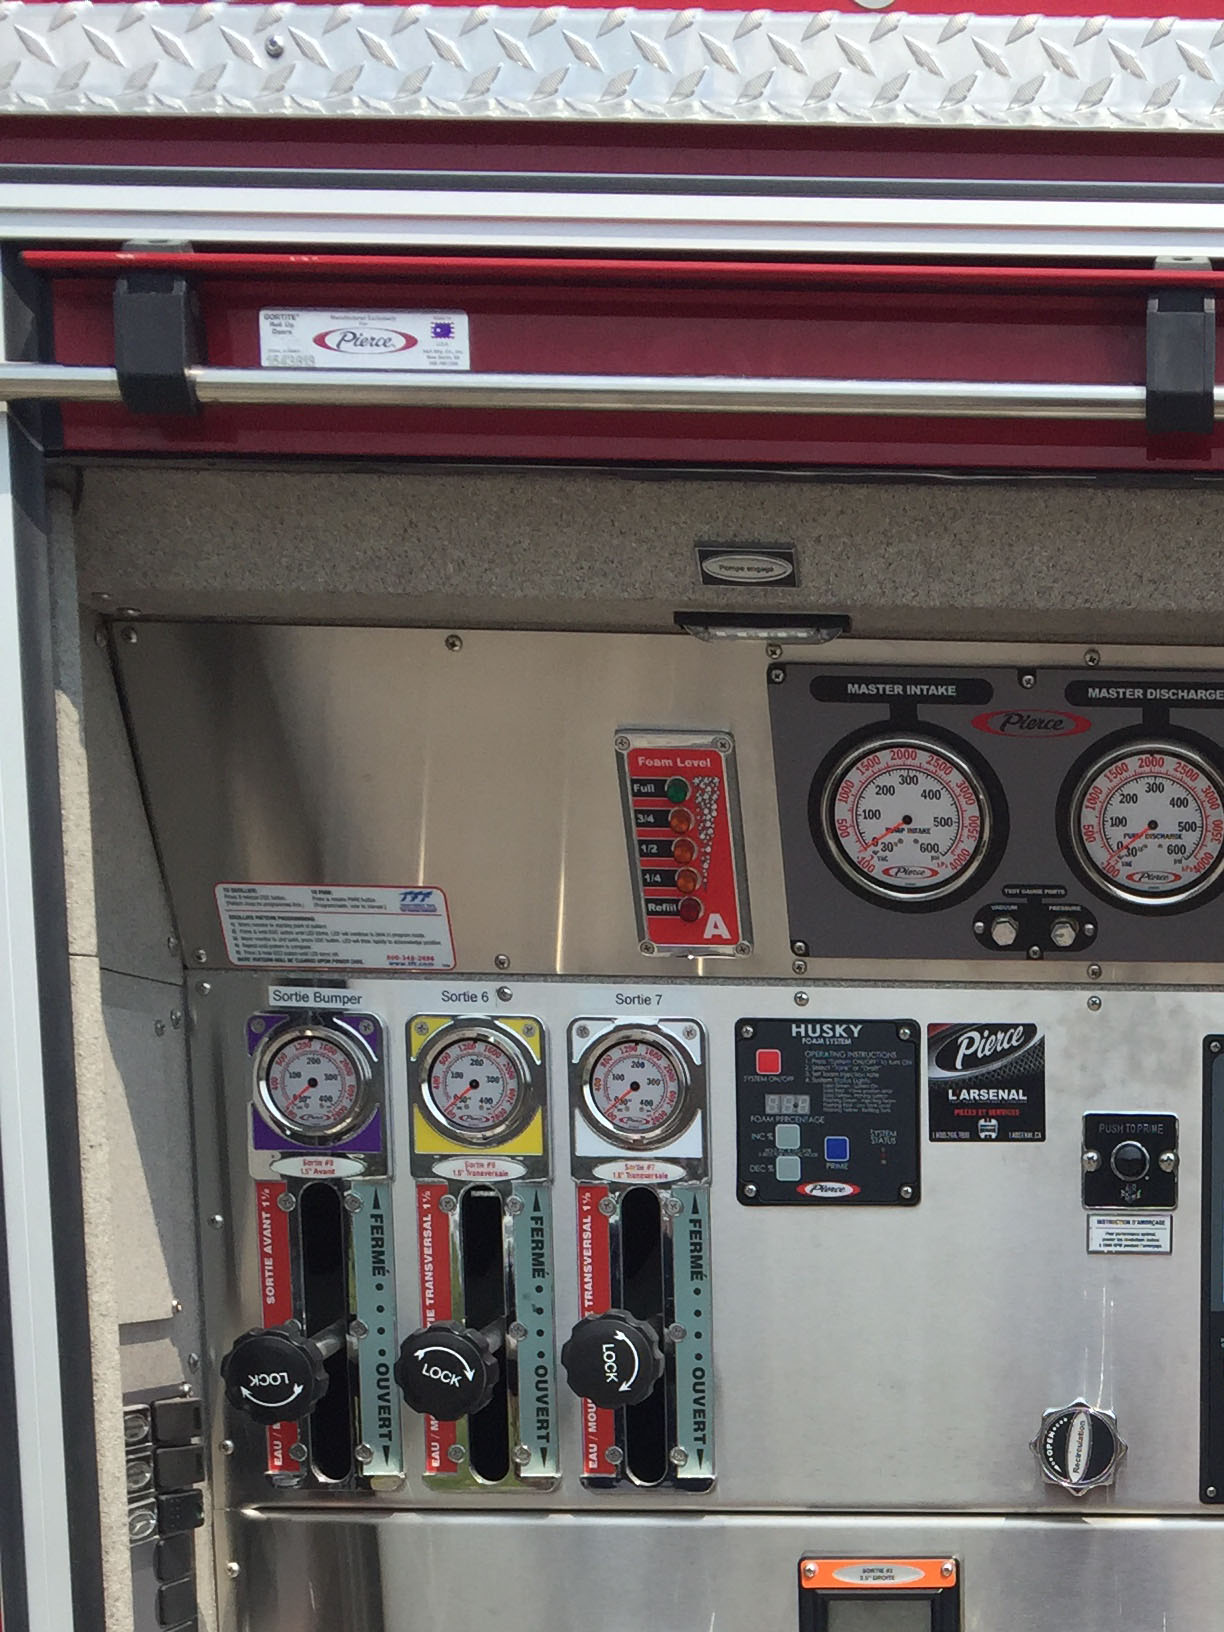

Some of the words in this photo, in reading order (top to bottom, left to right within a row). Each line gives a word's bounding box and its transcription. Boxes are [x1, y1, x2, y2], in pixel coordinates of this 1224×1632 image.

[336, 331, 394, 349] Pierce
[847, 684, 904, 695] MASTER
[907, 685, 956, 696] INTAKE
[1088, 688, 1143, 699] MASTER
[1147, 689, 1224, 700] DISCHARGE
[1000, 712, 1064, 732] Pierce
[638, 757, 673, 767] Foam
[677, 758, 711, 768] Level
[890, 750, 917, 761] 2000
[1138, 757, 1164, 768] 2000
[856, 755, 882, 776] 1500
[926, 755, 953, 776] 2500
[1104, 762, 1129, 783] 1500
[1173, 762, 1200, 783] 2500
[634, 784, 655, 793] Full
[899, 775, 918, 786] 300
[1145, 782, 1164, 794] 300
[838, 780, 854, 804] 1000
[875, 785, 895, 796] 200
[921, 789, 942, 800] 400
[956, 780, 975, 806] 3000
[1085, 786, 1103, 811] 1000
[1119, 793, 1138, 804] 200
[1201, 785, 1220, 811] 3000
[1169, 797, 1189, 808] 400
[637, 814, 655, 823] 3/4
[862, 810, 881, 820] 100
[933, 817, 953, 827] 500
[1110, 817, 1127, 828] 100
[837, 819, 849, 838] 500
[967, 816, 980, 841] 3500
[1083, 824, 1096, 843] 500
[1178, 821, 1197, 832] 500
[1211, 820, 1224, 844] 3500
[641, 845, 658, 853] 1/2
[920, 843, 939, 853] 600
[1167, 844, 1186, 855] 600
[644, 874, 662, 883] 1/4
[648, 903, 677, 912] Refill
[704, 914, 731, 939] A
[272, 990, 310, 1003] Sortie
[314, 992, 362, 1006] Bumper
[441, 990, 478, 1003] Sortie
[481, 992, 489, 1003] 6
[615, 993, 651, 1005] Sortie
[655, 995, 663, 1005] 7
[791, 1024, 863, 1038] HUSKY
[804, 1051, 847, 1059] OPERATING
[848, 1051, 897, 1059] INSTRUCTIONS
[956, 1026, 1024, 1069] Pierce
[776, 1116, 825, 1124] PERCENTAGE
[1099, 1124, 1123, 1134] PUSH
[1126, 1124, 1136, 1133] TO
[1137, 1124, 1164, 1134] PRIME
[810, 1183, 846, 1193] Pierce
[263, 1212, 273, 1255] AVANT
[370, 1213, 390, 1278] FERMÉ
[530, 1215, 550, 1279] FERMÉ
[689, 1218, 708, 1282] FERMÉ
[420, 1213, 435, 1307] TRANSVERSAL
[580, 1214, 594, 1307] TRANSVERSAL
[266, 1255, 275, 1305] SORTIE
[602, 1344, 618, 1383] LOCK
[248, 1372, 289, 1387] LOCK
[422, 1363, 462, 1388] LOCK
[376, 1363, 392, 1443] OUVERT
[535, 1365, 549, 1443] OUVERT
[692, 1366, 706, 1445] OUVERT
[1046, 1431, 1056, 1456] OPEN
[273, 1441, 283, 1466] EAU
[431, 1442, 440, 1468] EAU
[589, 1446, 598, 1469] EAU
